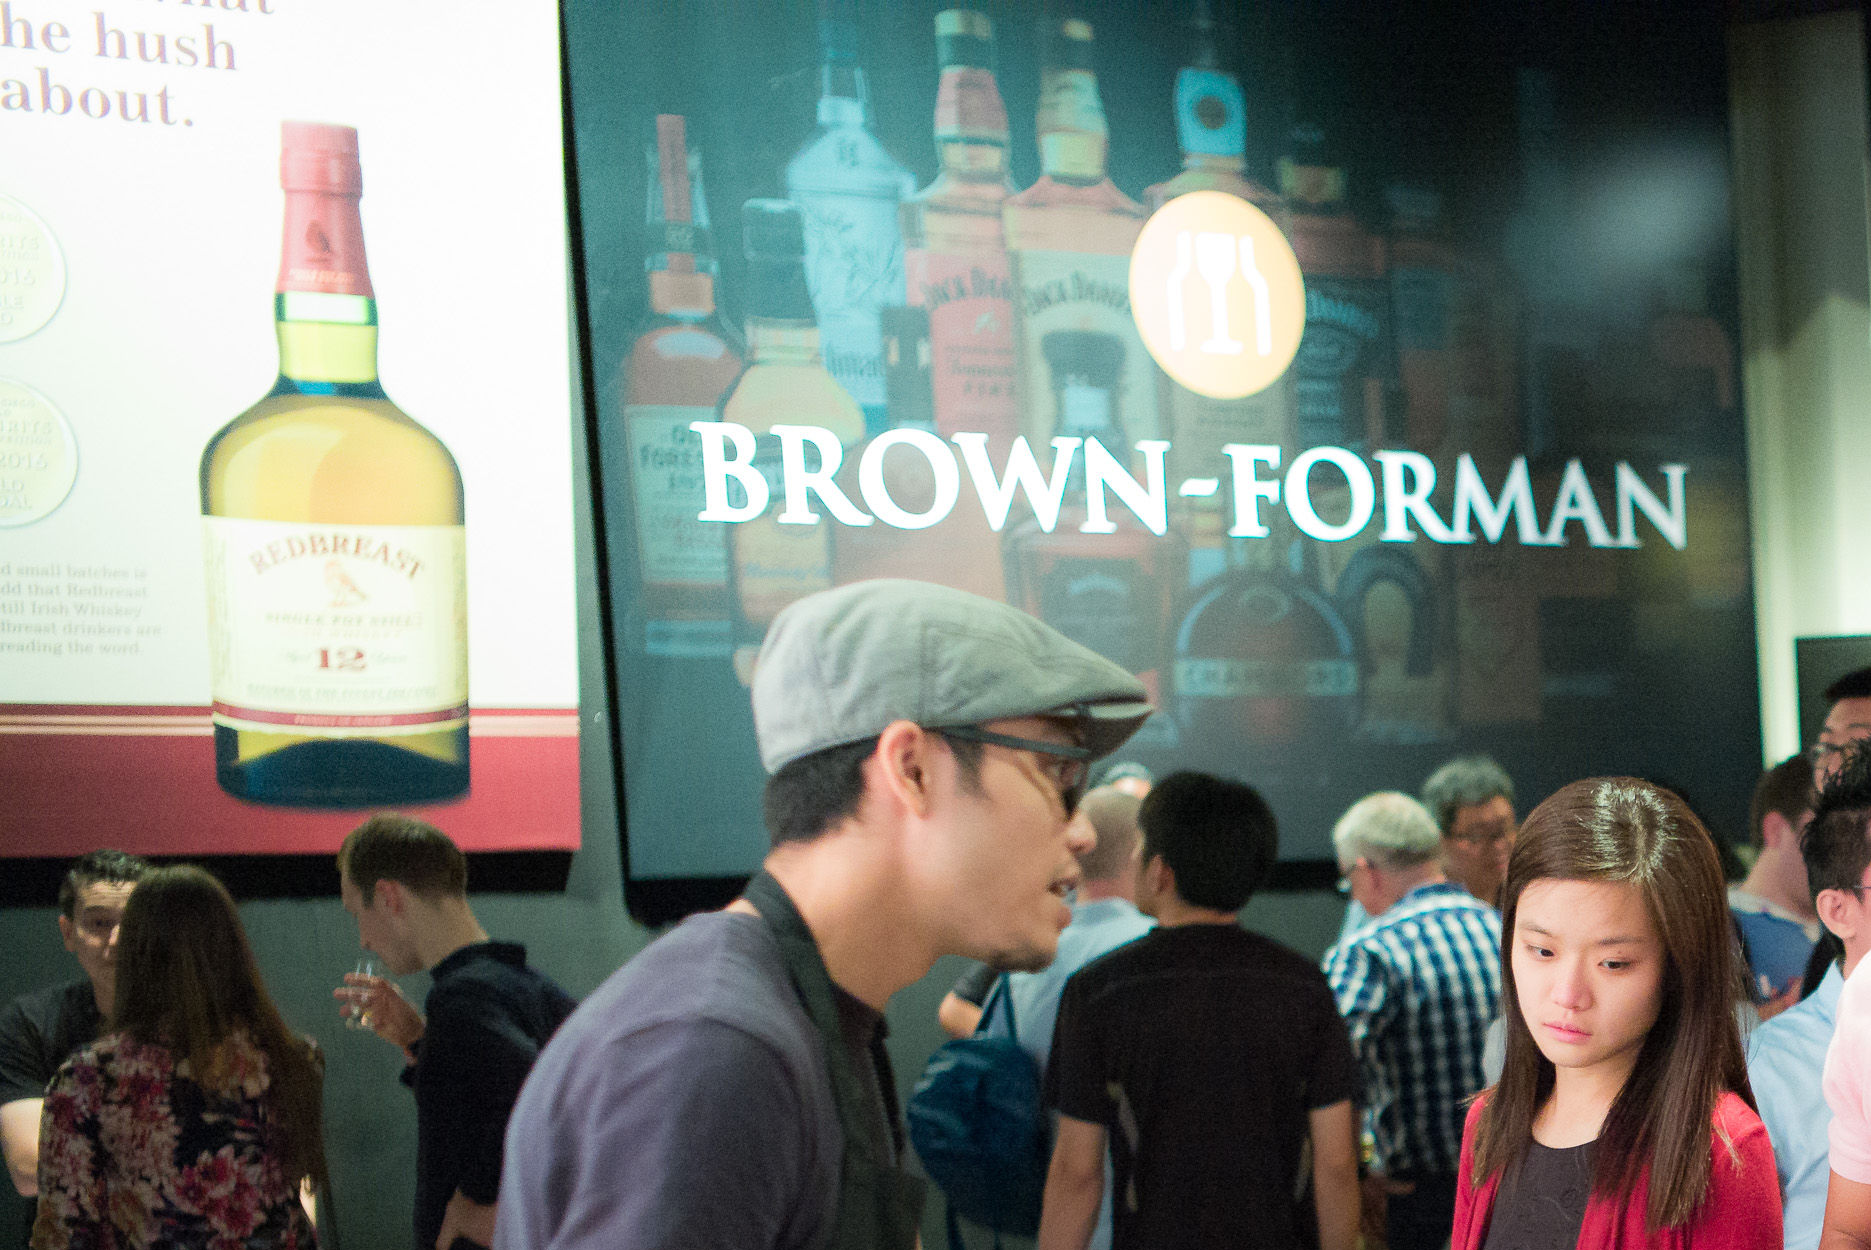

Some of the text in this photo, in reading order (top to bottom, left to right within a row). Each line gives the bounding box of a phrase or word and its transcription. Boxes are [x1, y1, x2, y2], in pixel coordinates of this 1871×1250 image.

[92, 11, 237, 71] hush
[1, 66, 193, 127] about.
[689, 418, 1689, 550] BROWN-FORMAN
[249, 532, 426, 580] REDBREAST
[317, 646, 368, 673] 12
